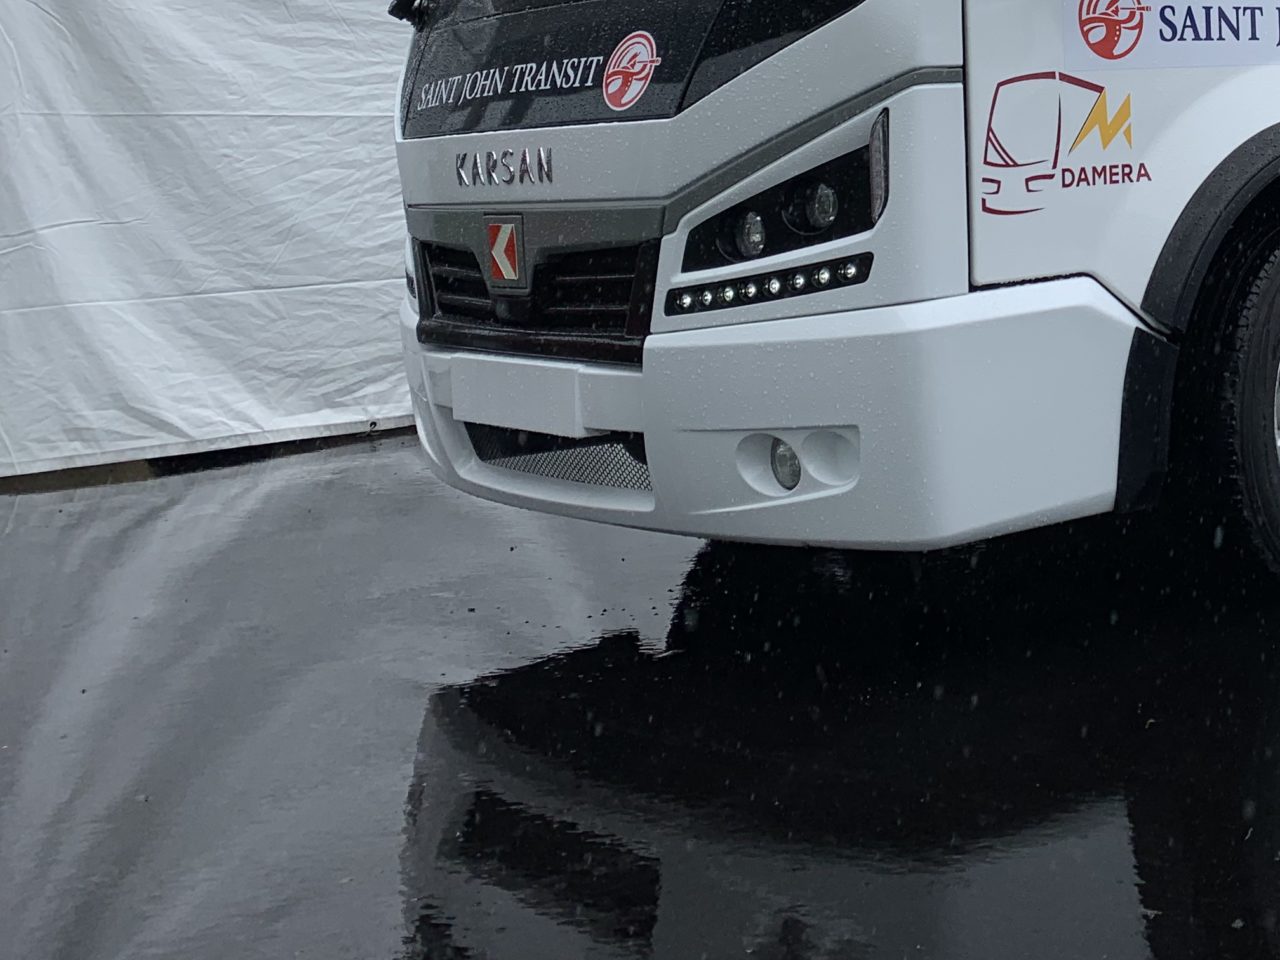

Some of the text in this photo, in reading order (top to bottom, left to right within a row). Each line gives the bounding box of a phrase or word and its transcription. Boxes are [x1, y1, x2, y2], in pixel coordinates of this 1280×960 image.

[1159, 5, 1263, 42] SAINT
[417, 56, 603, 111] SAINT JOHN TRANSIT
[455, 146, 553, 187] KARSAN
[1061, 162, 1152, 188] DAMERA
